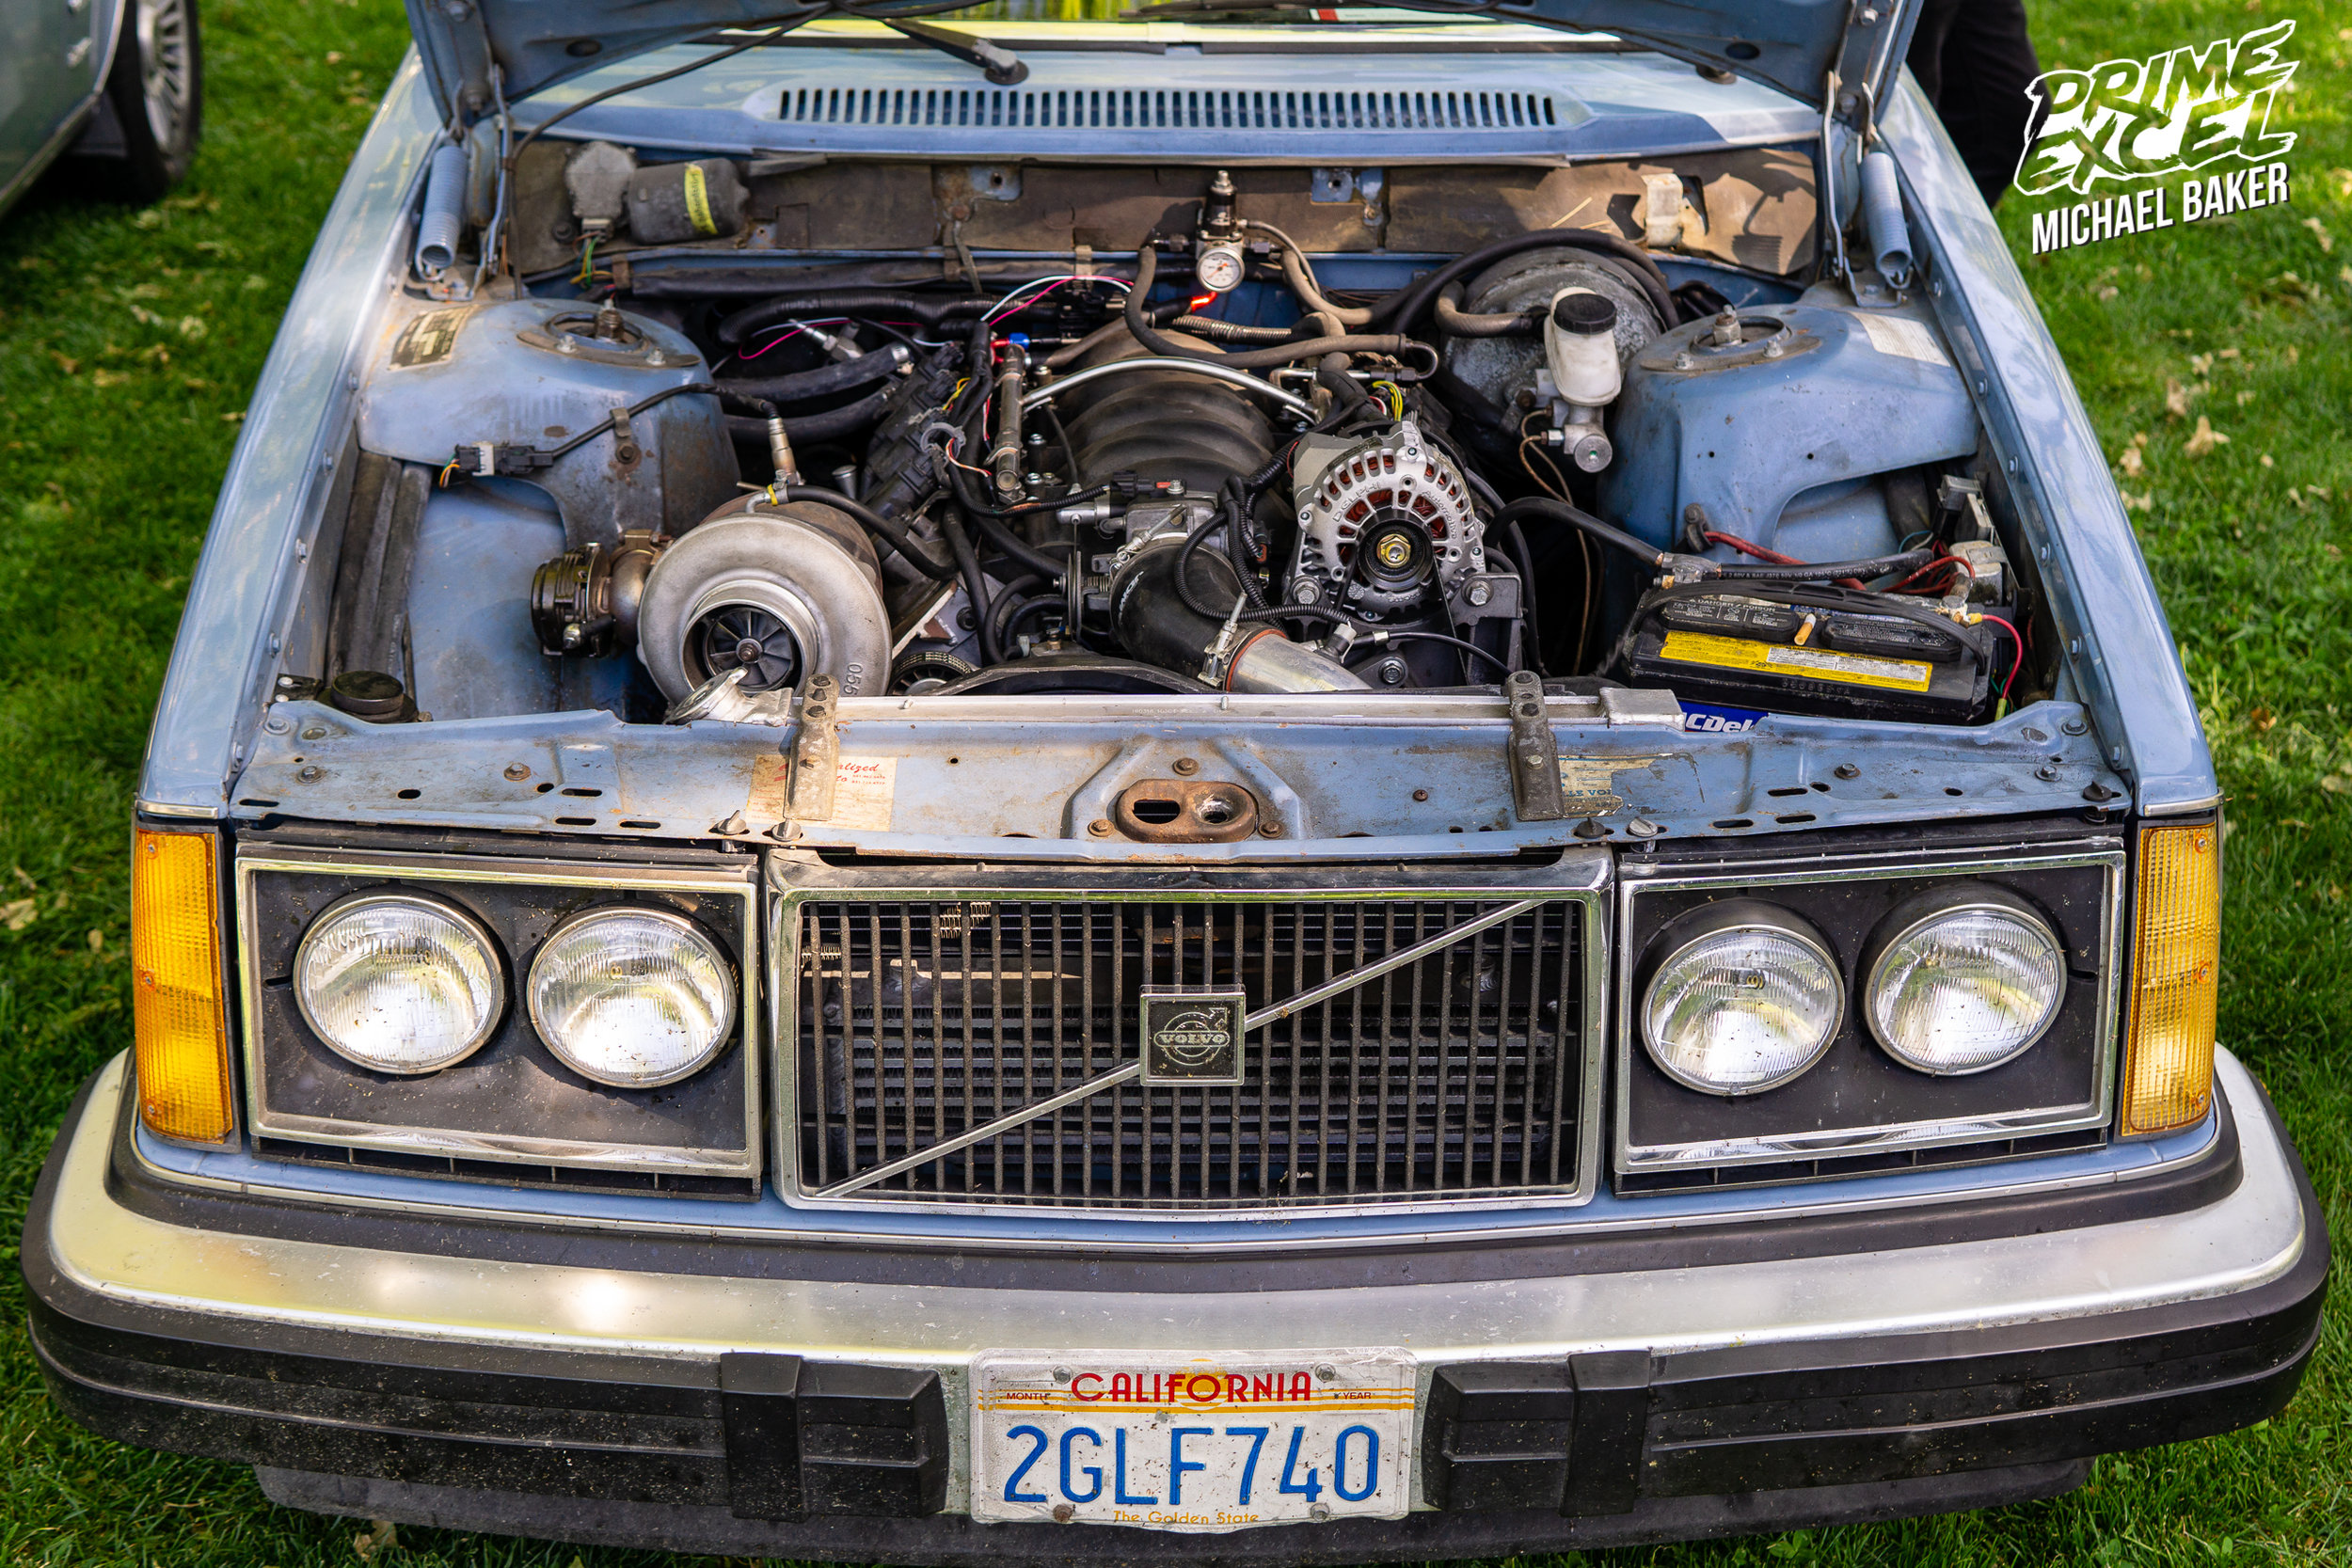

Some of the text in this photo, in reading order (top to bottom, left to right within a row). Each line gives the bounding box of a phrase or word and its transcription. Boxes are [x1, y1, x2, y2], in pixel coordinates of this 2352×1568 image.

[1683, 712, 1756, 733] CDel
[1158, 1034, 1227, 1044] VOLVO
[1071, 1371, 1311, 1402] CALIFORNIA
[1004, 1423, 1380, 1505] 2GLF740
[1113, 1511, 1259, 1525] The Golden State
